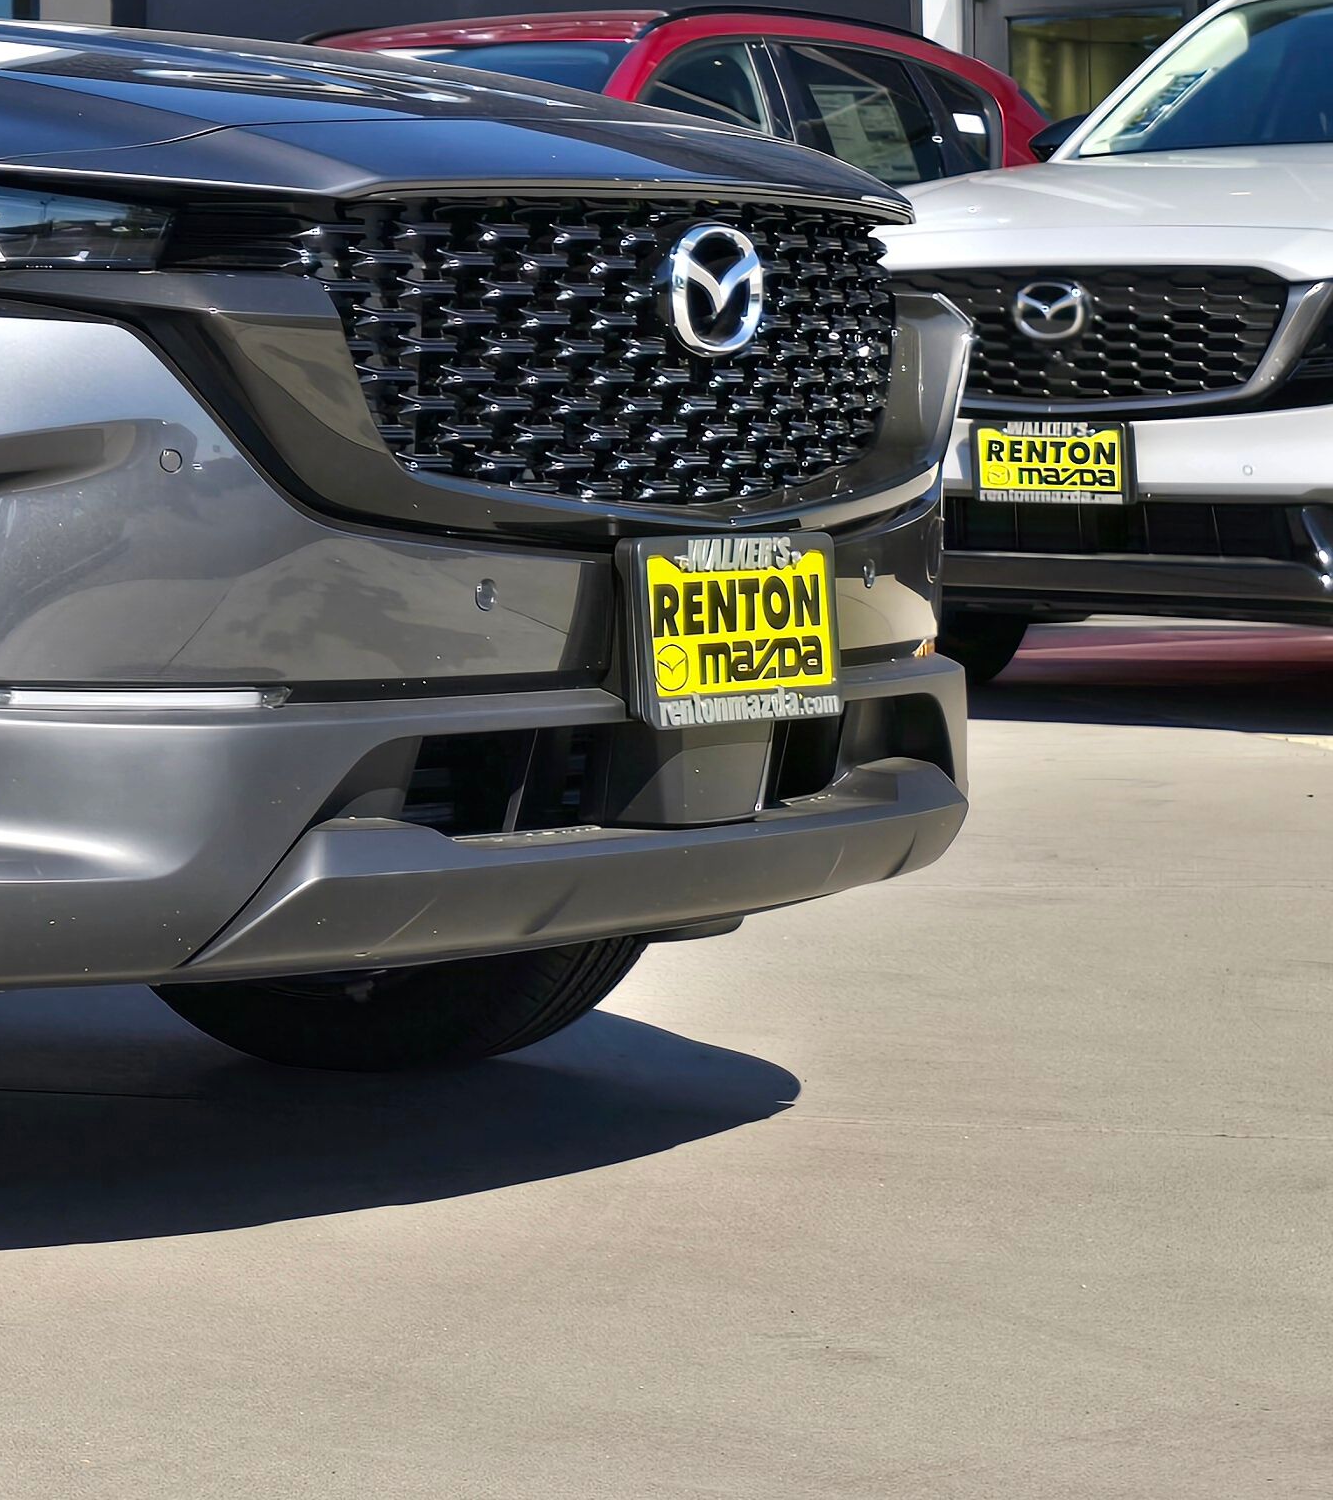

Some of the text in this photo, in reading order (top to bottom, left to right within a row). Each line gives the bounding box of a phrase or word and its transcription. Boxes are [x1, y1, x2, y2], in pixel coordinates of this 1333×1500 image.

[986, 439, 1116, 465] RENTON
[1018, 467, 1116, 487] mazda
[687, 536, 793, 573] WALKER'S
[652, 574, 822, 638] RENTON
[698, 635, 823, 685] mazda
[658, 685, 840, 727] rentonmazda.com
